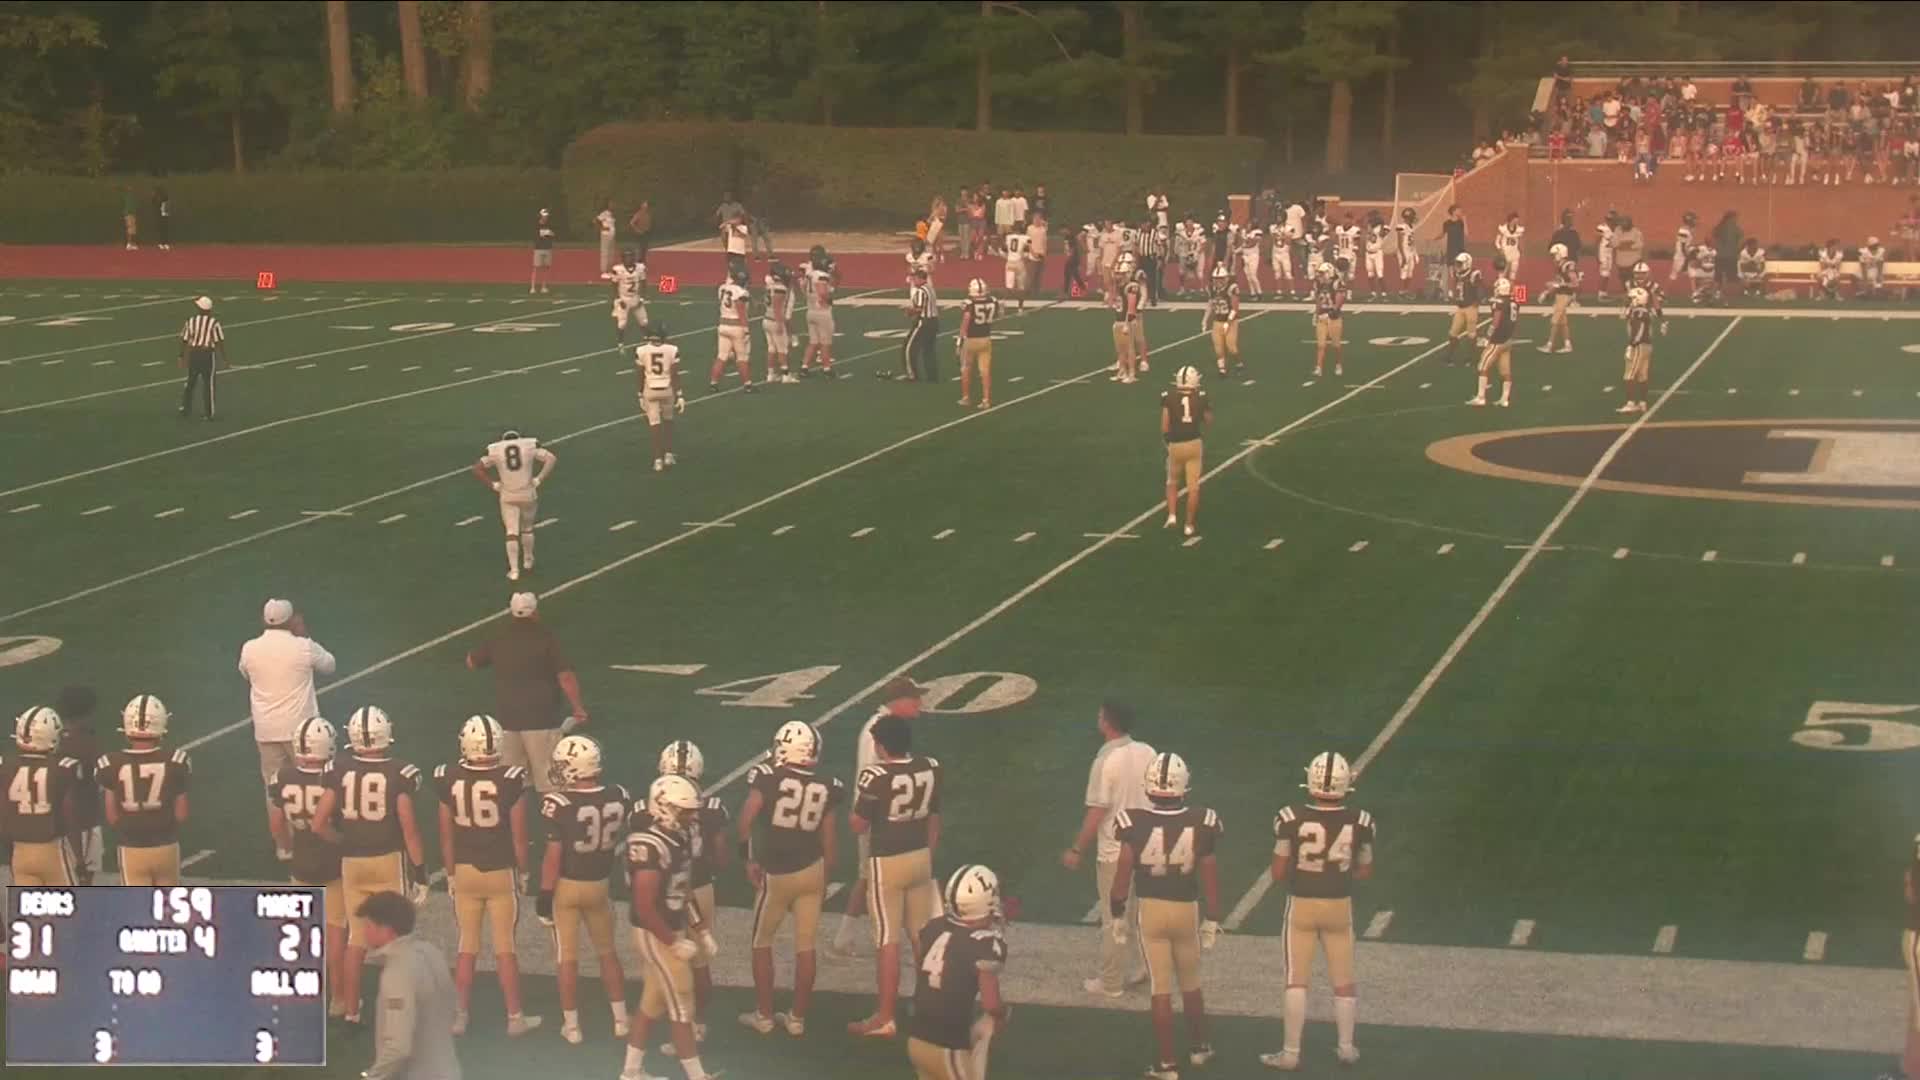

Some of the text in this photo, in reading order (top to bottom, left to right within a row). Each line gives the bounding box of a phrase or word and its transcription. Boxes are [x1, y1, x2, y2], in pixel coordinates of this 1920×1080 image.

[974, 303, 995, 325] 57
[651, 353, 663, 376] 5
[1182, 396, 1193, 423] 1
[505, 445, 523, 472] 8
[782, 729, 793, 744] L
[8, 766, 52, 814] 41
[119, 763, 166, 812] 17
[342, 771, 387, 821] 18
[451, 780, 499, 828] 16
[772, 777, 828, 831] 28
[888, 770, 934, 822] 27
[574, 801, 625, 853] 32
[1140, 826, 1195, 876] 44
[1297, 821, 1353, 872] 24
[922, 931, 952, 989] 4
